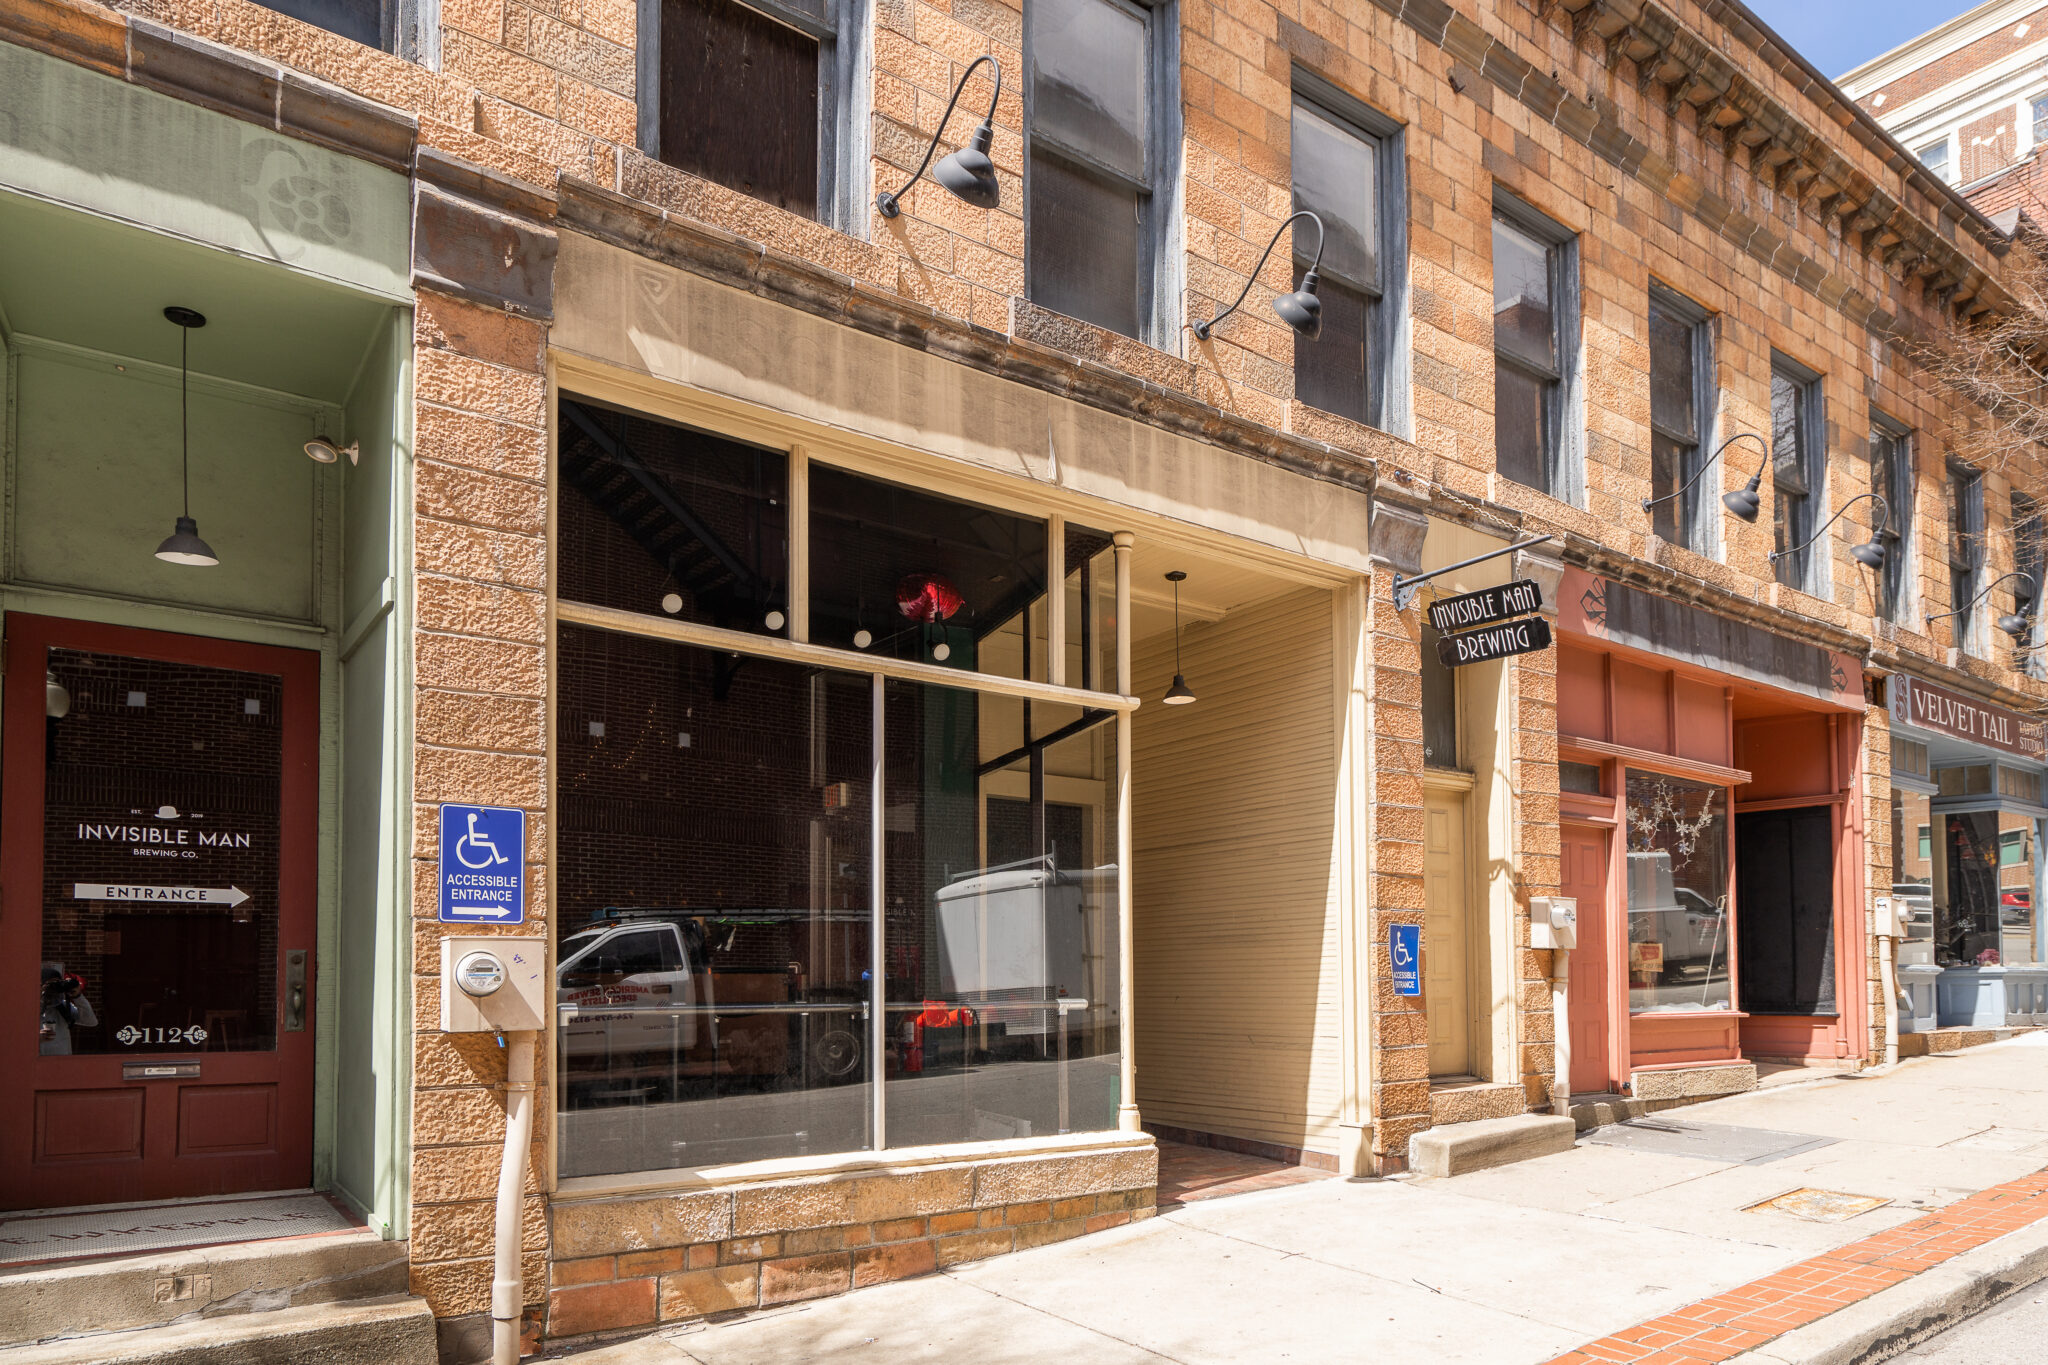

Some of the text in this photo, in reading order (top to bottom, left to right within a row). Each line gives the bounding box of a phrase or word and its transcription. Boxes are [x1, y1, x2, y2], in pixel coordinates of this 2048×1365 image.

[1432, 584, 1536, 629] INVISIBLE MAN
[1456, 625, 1530, 661] BREWING
[1913, 688, 2013, 745] VELVET TAIL
[2019, 736, 2044, 753] STUDIO
[78, 823, 251, 848] INVISIBLE MAN
[133, 848, 199, 859] BREWING CO.
[446, 873, 518, 888] ACCESSIBLE
[106, 886, 207, 901] ENTRANCE
[451, 888, 513, 902] ENTRANCE
[1394, 971, 1417, 980] ACCESSIBLE
[141, 1027, 182, 1044] 112
